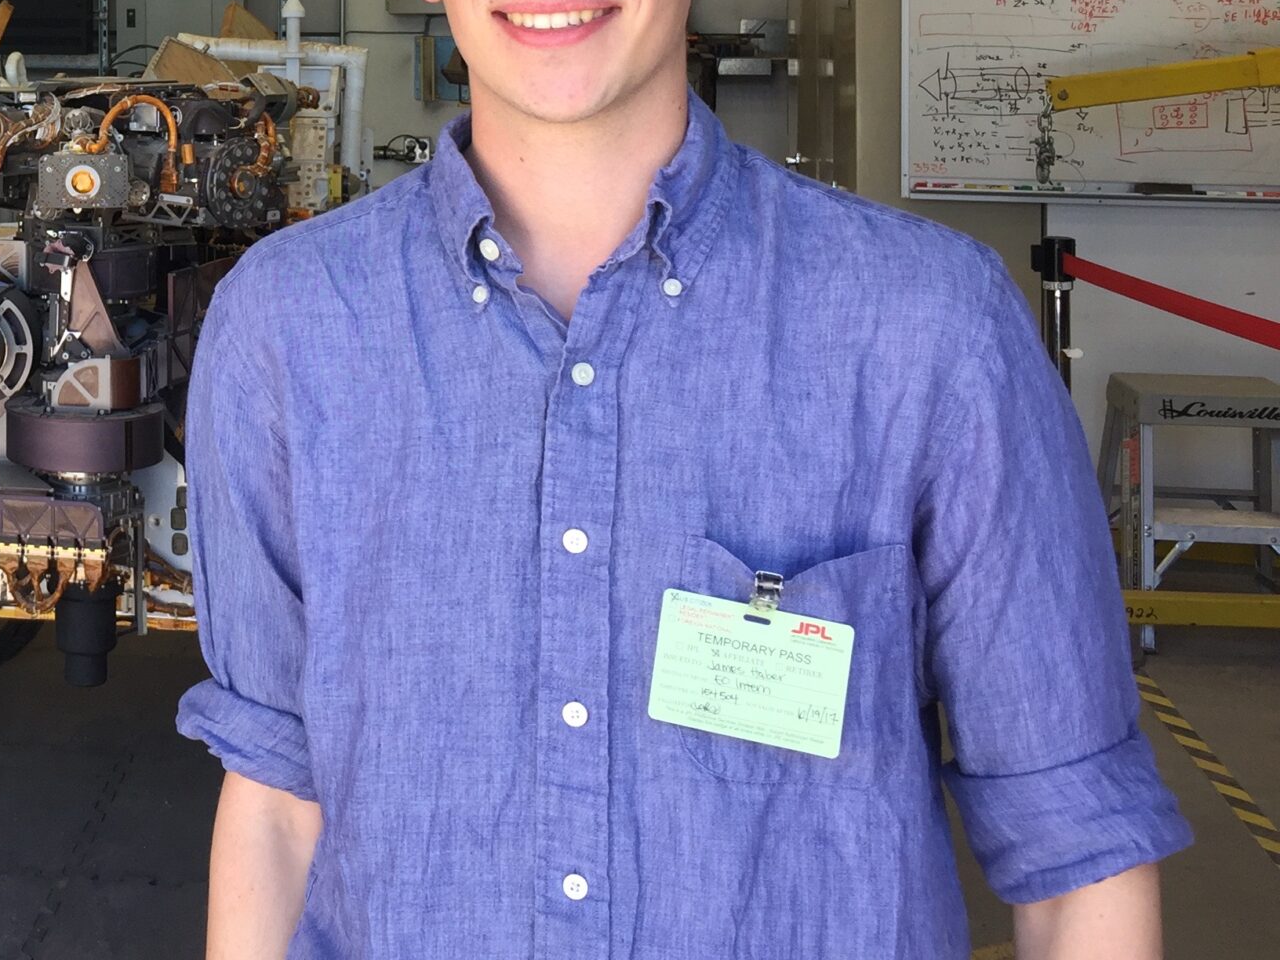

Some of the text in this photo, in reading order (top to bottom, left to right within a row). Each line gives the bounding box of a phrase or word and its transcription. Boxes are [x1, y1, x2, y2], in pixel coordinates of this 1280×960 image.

[1159, 400, 1280, 421] Louisville
[791, 621, 833, 641] JPL
[698, 631, 776, 657] TEMPORARY
[779, 648, 812, 665] PASS
